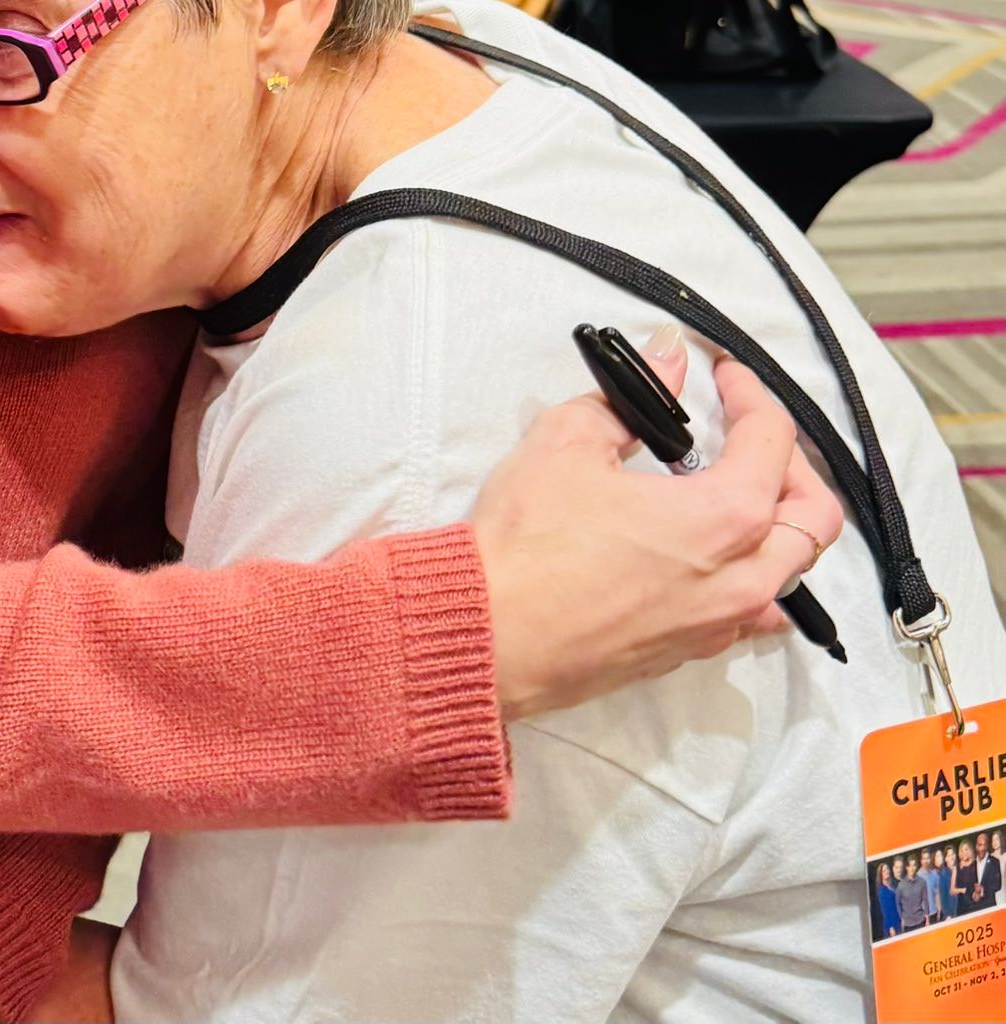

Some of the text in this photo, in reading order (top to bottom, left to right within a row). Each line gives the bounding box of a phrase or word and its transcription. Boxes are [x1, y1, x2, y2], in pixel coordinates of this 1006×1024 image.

[940, 785, 993, 822] PUB
[956, 923, 993, 947] 2025
[923, 952, 973, 975] GENERAL
[934, 985, 952, 998] OCT
[970, 974, 988, 987] NOV
